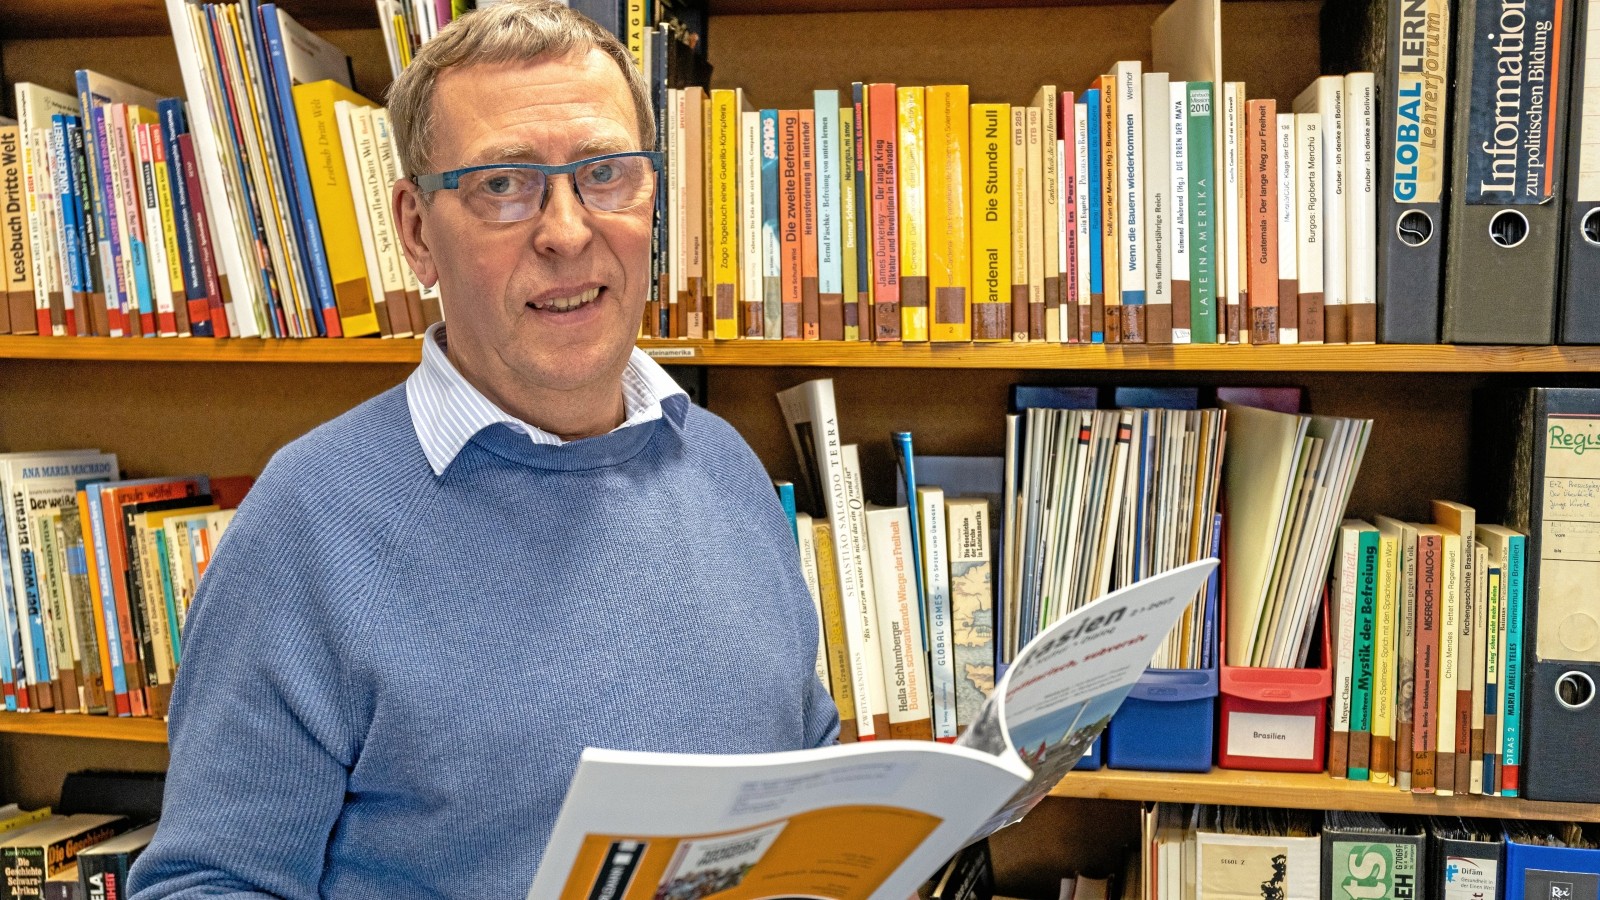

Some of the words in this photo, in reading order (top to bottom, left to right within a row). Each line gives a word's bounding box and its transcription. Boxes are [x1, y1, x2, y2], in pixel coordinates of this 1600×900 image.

[1401, 0, 1426, 73] LERN
[1528, 20, 1552, 82] Bildung
[1420, 12, 1443, 148] Lehrerforum
[1174, 100, 1182, 120] MAYA
[1191, 104, 1210, 112] 2010
[1259, 105, 1267, 137] Freiheit
[97, 116, 106, 136] WELT
[821, 117, 829, 139] lernen
[985, 110, 998, 138] Null
[1175, 122, 1183, 135] DER
[1365, 117, 1370, 127] an
[1525, 85, 1544, 168] politischen
[1, 132, 17, 165] Welt
[719, 104, 729, 180] Guerilla-Kämpferin
[784, 117, 798, 178] Befreiung
[802, 121, 811, 158] Hinterhof
[874, 139, 885, 161] Krieg
[1125, 114, 1136, 189] wiederkommen
[1175, 137, 1183, 158] ERBEN
[1306, 136, 1316, 169] Menchú
[1394, 82, 1422, 201] GLOBAL
[102, 159, 111, 173] DER
[802, 160, 810, 170] im
[885, 141, 894, 175] Salvador
[985, 142, 998, 195] Stunde
[1175, 160, 1183, 171] DIE
[1259, 153, 1268, 172] Weg
[105, 174, 112, 183] IN
[875, 162, 886, 184] lange
[886, 176, 894, 184] El
[1176, 176, 1185, 192] (Hg.)
[1259, 173, 1268, 198] lange
[1364, 168, 1372, 192] Gruber
[1526, 170, 1539, 196] zur
[4, 168, 20, 213] Dritte
[105, 184, 116, 219] ZUKUNFT
[785, 179, 796, 219] zweite
[802, 172, 813, 235] Herausforderung
[822, 174, 831, 207] Befreiung
[875, 186, 884, 200] Der
[887, 186, 894, 194] in
[1154, 193, 1162, 213] Reich
[1306, 170, 1316, 211] Rigoberta
[886, 199, 896, 236] Revolution
[985, 199, 998, 222] Die
[1127, 191, 1136, 225] Bauern
[1176, 194, 1184, 225] Allebrand
[1259, 199, 1267, 214] Der
[109, 217, 119, 244] UNSERE
[720, 204, 729, 245] Tagebuch
[785, 221, 797, 242] Die
[822, 213, 831, 240] Päschke
[875, 213, 887, 257] Dunkerley
[1128, 227, 1136, 242] die
[1307, 212, 1316, 243] Burgos:
[5, 214, 26, 283] Lesebuch
[823, 242, 831, 263] Bernd
[888, 238, 896, 252] und
[1154, 214, 1163, 280] fünfhundertjährige
[1177, 227, 1185, 254] Raimund
[1197, 177, 1209, 316] LATEINAMERIKA
[1260, 220, 1268, 264] Guatemala
[720, 247, 729, 269] Zago
[887, 254, 897, 285] Diktatur
[1128, 244, 1137, 272] Wenn
[115, 255, 126, 293] KINDER
[876, 259, 886, 287] James
[986, 248, 998, 302] ardenal
[1155, 281, 1163, 295] Das
[826, 418, 839, 468] TERRA
[23, 467, 42, 479] ANA
[43, 465, 71, 476] MARIA
[71, 463, 110, 475] MACHADO
[832, 473, 847, 529] SALGADO
[12, 491, 29, 545] Elefant
[975, 510, 984, 551] Lateinamerika
[138, 528, 148, 556] Straße
[890, 520, 904, 555] Freiheit
[962, 517, 972, 548] Geschichte
[969, 528, 977, 547] Kirche
[839, 532, 855, 597] SEBASTIÃO
[894, 556, 904, 571] der
[962, 549, 971, 558] Die
[1405, 545, 1414, 561] Volk
[1512, 544, 1520, 578] Brasilien
[143, 557, 151, 578] einer
[1360, 546, 1376, 615] Befreiung
[1406, 562, 1414, 576] das
[1448, 550, 1457, 589] Regenwald!
[147, 580, 153, 590] an
[896, 572, 910, 602] Wiege
[1407, 577, 1415, 598] gegen
[1447, 590, 1455, 603] den
[1511, 579, 1519, 588] in
[27, 591, 39, 617] Der
[148, 592, 158, 619] bauen
[1446, 604, 1454, 626] Rettet
[1510, 588, 1519, 634] Feminismus
[152, 621, 160, 636] Wir
[1360, 618, 1371, 641] der
[1405, 599, 1414, 637] Staudamm
[899, 602, 915, 668] schwankende
[1446, 631, 1454, 658] Mendes
[890, 620, 906, 686] Schlumberger
[1508, 642, 1517, 662] TELES
[1357, 644, 1372, 691] Mystik
[1444, 659, 1453, 679] Chico
[1506, 663, 1517, 690] AMÉLIA
[855, 651, 870, 727] ZWEITAUSENDEINS
[896, 687, 908, 712] Hella
[904, 668, 919, 711] Bolivien,
[1507, 692, 1516, 716] MARIA
[1253, 732, 1286, 740] Brasilien
[1506, 737, 1515, 765] OTRAS
[5, 867, 42, 877] Geschichte
[17, 858, 30, 867] Die
[1461, 868, 1483, 876] Difäm
[7, 878, 41, 886] Schwarz-
[11, 886, 38, 895] Afrikas
[1460, 877, 1488, 885] Gesundheit
